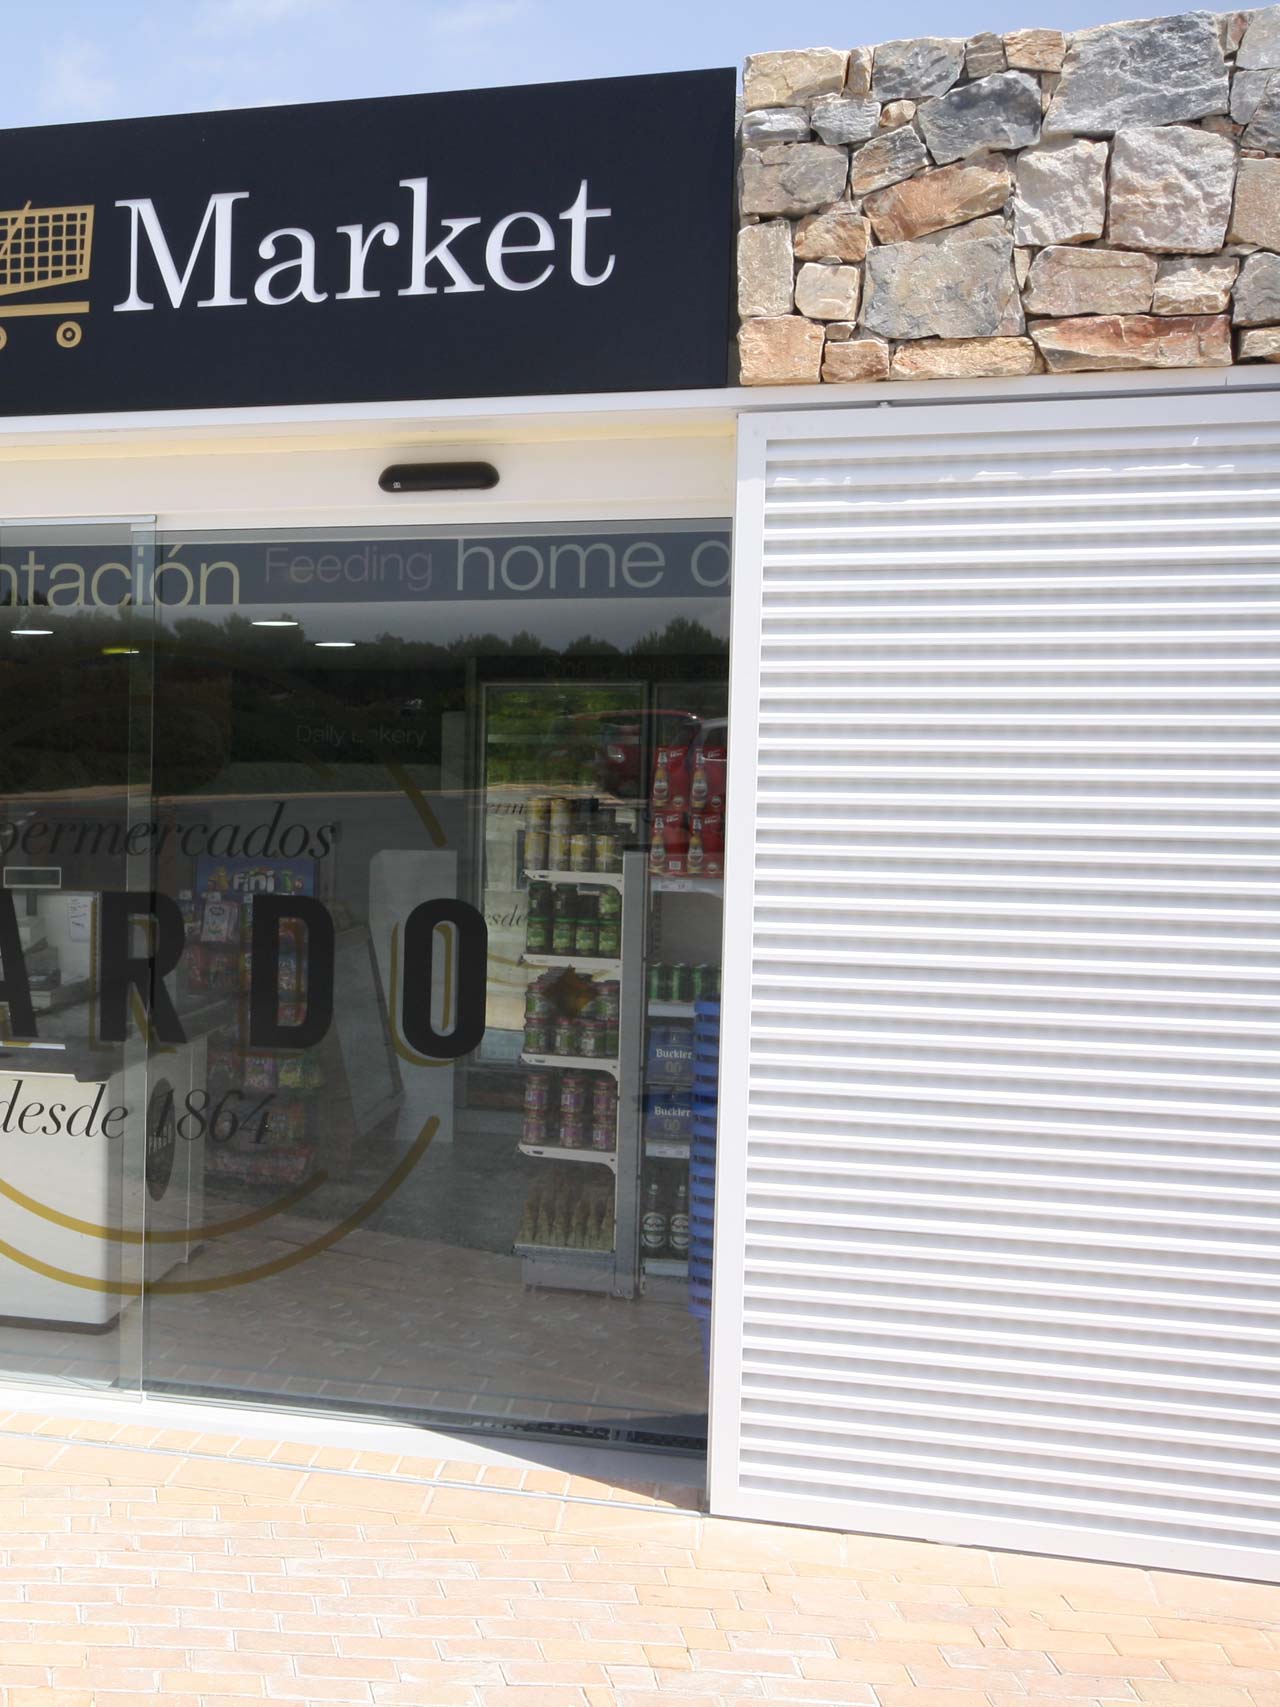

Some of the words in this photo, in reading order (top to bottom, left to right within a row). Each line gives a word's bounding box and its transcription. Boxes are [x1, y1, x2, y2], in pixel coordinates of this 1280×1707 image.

[113, 177, 615, 312] Market
[265, 546, 432, 592] Feeding
[457, 537, 665, 592] home
[296, 724, 346, 746] Daily
[352, 724, 426, 747] kery
[656, 1048, 693, 1060] Buckler
[152, 1088, 276, 1146] 1864
[654, 1106, 691, 1117] Buckler
